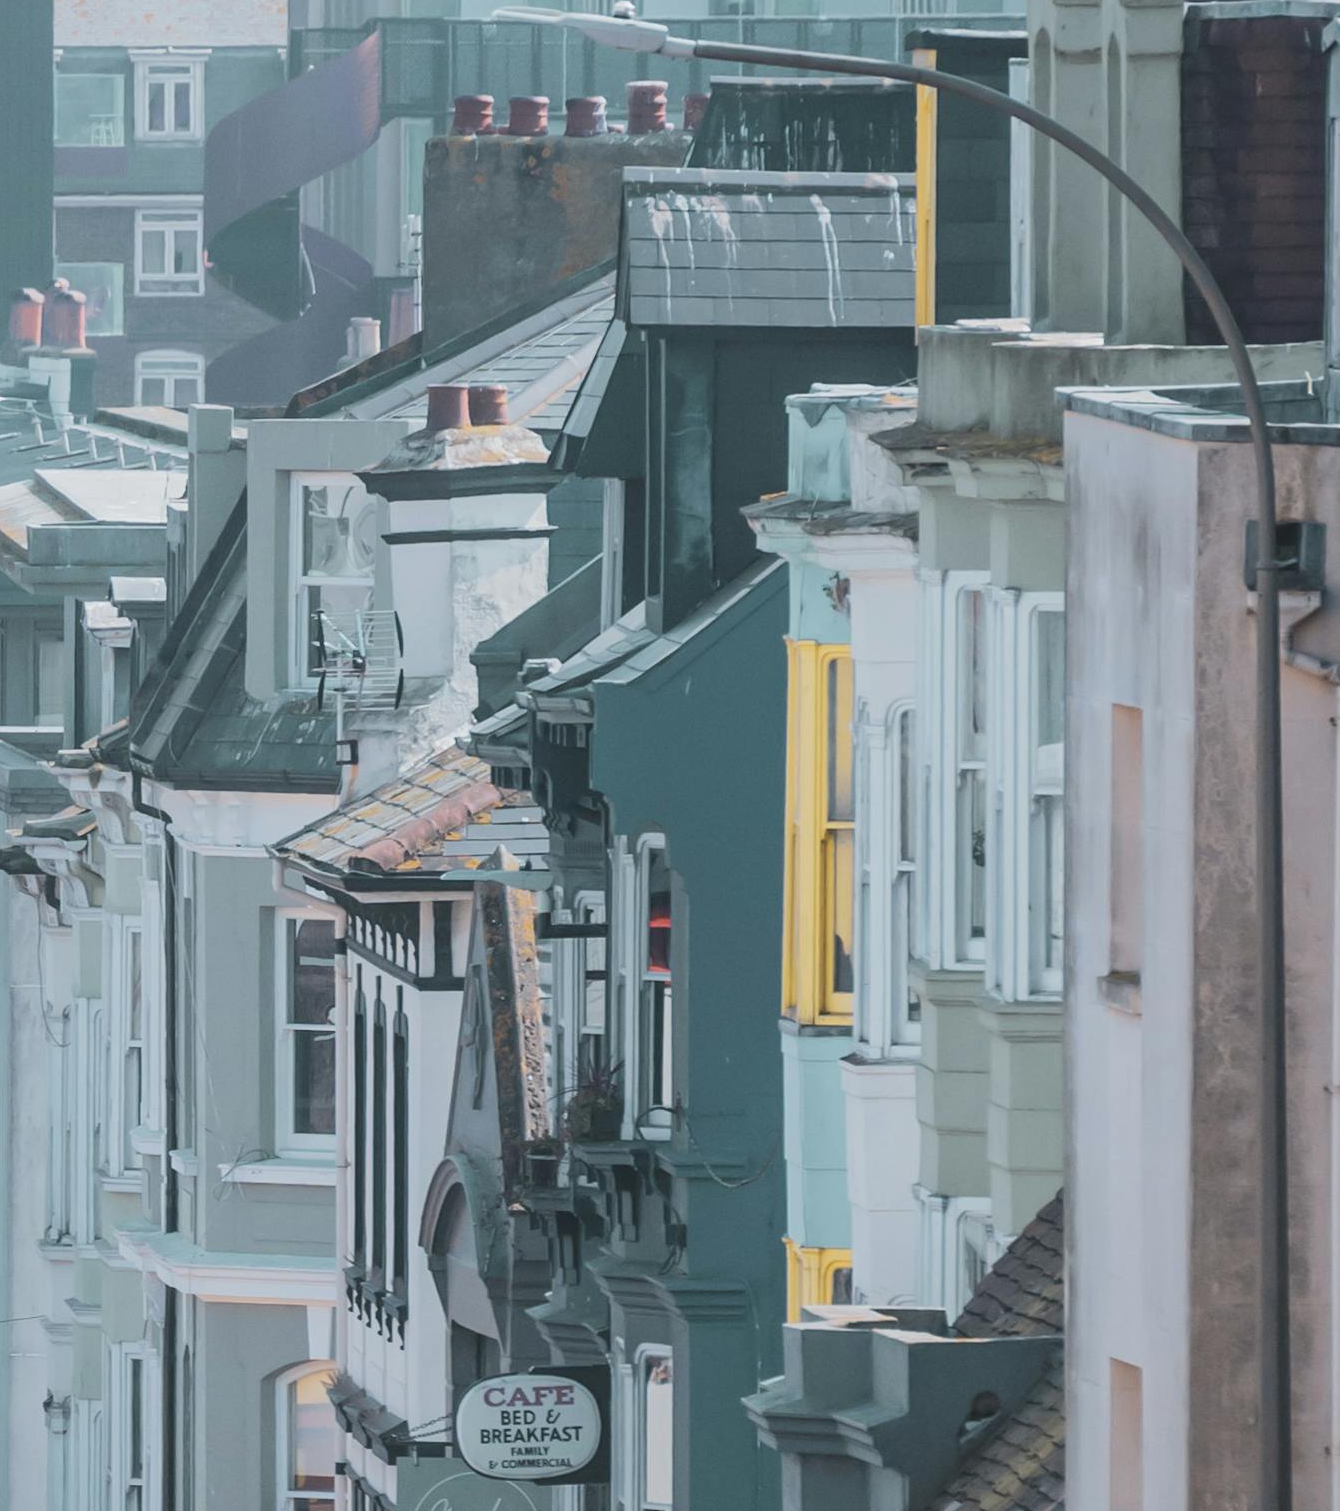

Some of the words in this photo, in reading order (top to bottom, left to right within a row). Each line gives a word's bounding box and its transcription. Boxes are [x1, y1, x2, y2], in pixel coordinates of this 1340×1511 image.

[484, 1385, 575, 1407] CAFE
[501, 1410, 536, 1426] BED
[546, 1409, 561, 1424] &
[480, 1426, 583, 1444] BREAKFAST
[511, 1446, 550, 1456] FAMILY
[489, 1460, 498, 1469] &
[501, 1458, 572, 1469] COMMERCIAL
